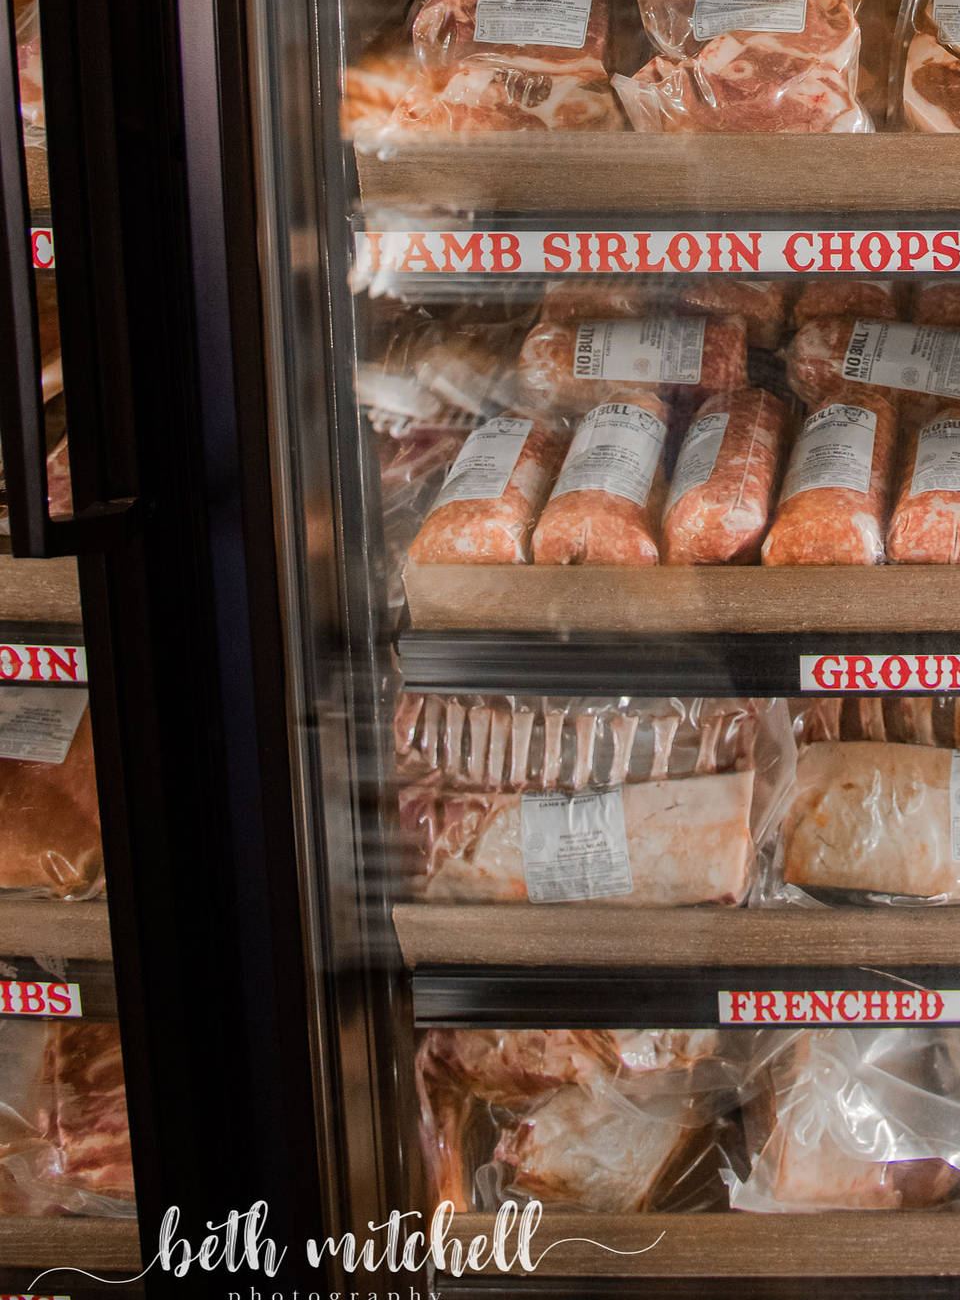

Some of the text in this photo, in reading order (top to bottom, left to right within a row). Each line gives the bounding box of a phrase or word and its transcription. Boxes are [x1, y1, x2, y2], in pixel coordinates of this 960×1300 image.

[543, 232, 762, 273] SIRLOIN
[783, 231, 960, 273] CHOPS
[576, 326, 595, 375] NO BULL
[845, 331, 869, 377] NO BULL
[860, 353, 872, 378] MEATS
[597, 404, 630, 416] BULL
[729, 990, 945, 1022] FRENCHED
